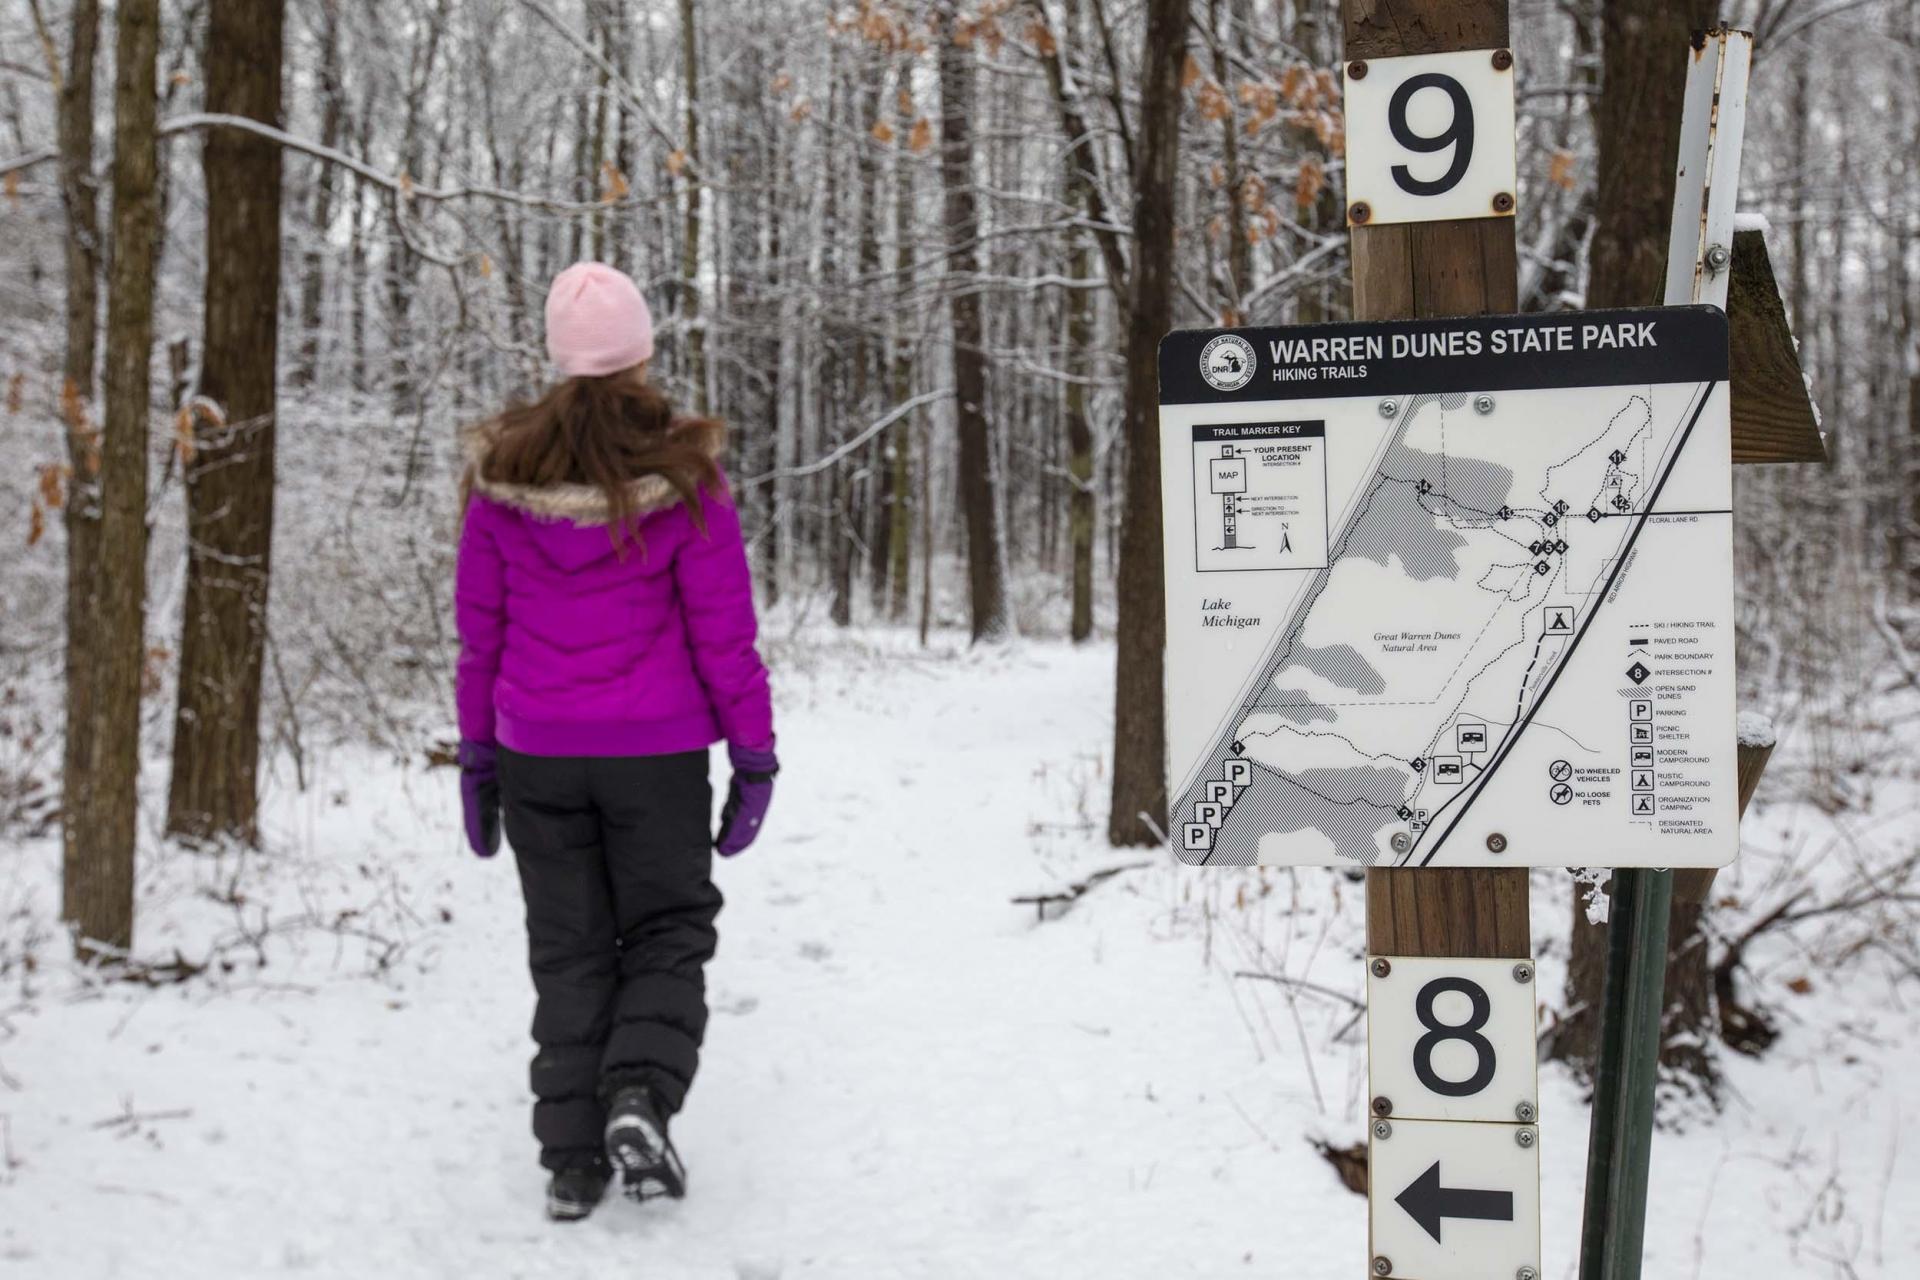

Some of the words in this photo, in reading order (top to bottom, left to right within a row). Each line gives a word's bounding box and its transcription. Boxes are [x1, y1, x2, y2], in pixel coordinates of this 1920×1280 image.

[1388, 72, 1474, 196] 9
[1270, 335, 1383, 364] WARREN
[1392, 330, 1482, 360] DUNES
[1490, 325, 1573, 354] STATE
[1582, 322, 1657, 349] PARK
[1212, 365, 1229, 373] DNR
[1272, 367, 1317, 382] HIKING
[1320, 365, 1367, 379] TRAILS
[1212, 427, 1239, 436] TRAIL
[1241, 426, 1280, 435] MARKER
[1282, 425, 1301, 433] KEY
[1613, 453, 1622, 461] 11
[1555, 502, 1567, 513] 10
[1622, 504, 1631, 513] P
[1501, 509, 1512, 518] 13
[1591, 511, 1598, 520] 9
[1547, 515, 1554, 524] 8
[1281, 522, 1289, 530] N
[1533, 543, 1540, 553] 7
[1545, 543, 1553, 553] 5
[1557, 542, 1564, 552] 4
[1539, 563, 1545, 573] 6
[1607, 592, 1617, 604] RED
[1614, 571, 1627, 592] ARROW
[1623, 548, 1638, 573] HIGHWAY
[1201, 598, 1231, 610] Lake
[1202, 614, 1261, 629] Michigan
[1374, 633, 1398, 641] Great
[1400, 632, 1432, 641] Warren
[1434, 632, 1461, 640] Dunes
[1382, 643, 1415, 652] Natural
[1417, 643, 1437, 652] Area
[1634, 668, 1642, 679] 8
[1636, 705, 1647, 717] P
[1415, 760, 1422, 770] 3
[1232, 765, 1245, 781] P
[1214, 786, 1227, 802] P
[1203, 807, 1216, 823] P
[1402, 809, 1409, 819] 2
[1418, 811, 1426, 820] P
[1191, 828, 1204, 844] P
[1412, 977, 1496, 1097] 8
